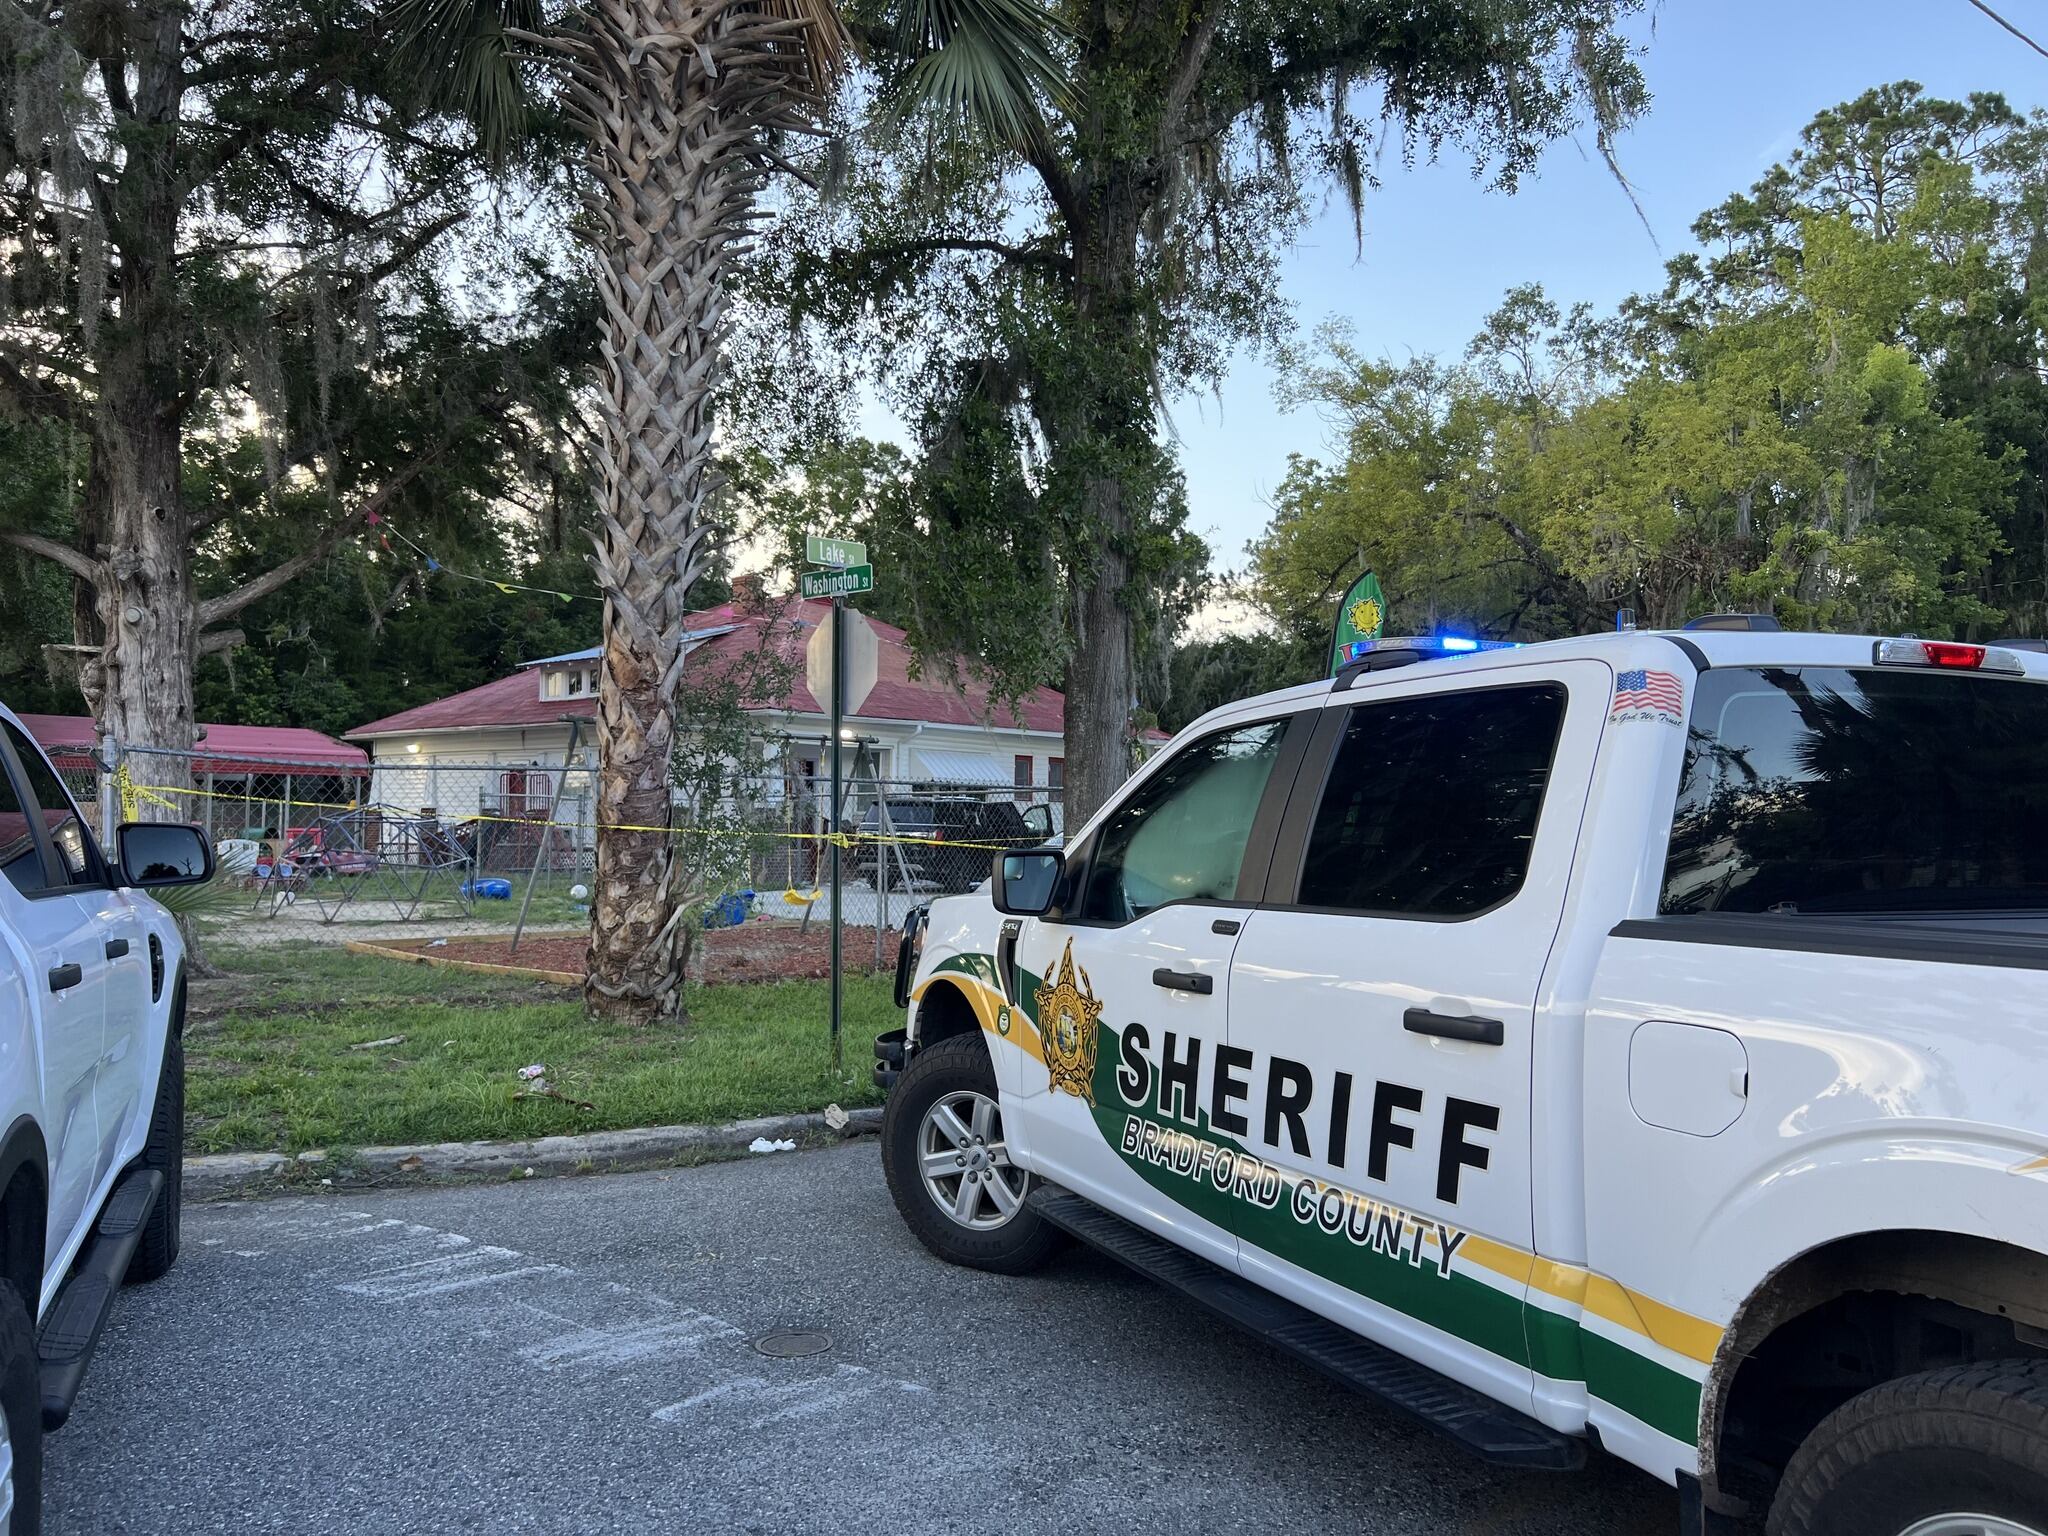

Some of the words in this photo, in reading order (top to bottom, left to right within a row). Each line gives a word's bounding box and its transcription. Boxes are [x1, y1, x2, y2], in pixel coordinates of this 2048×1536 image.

[819, 541, 846, 563] Lake
[804, 571, 859, 596] Washington
[1619, 712, 1638, 723] God
[1640, 711, 1655, 720] We
[1658, 712, 1682, 726] Trust
[1117, 1022, 1501, 1205] SHERIFF
[1121, 1115, 1281, 1208] BRADFORD
[1292, 1178, 1470, 1279] COUNTY
